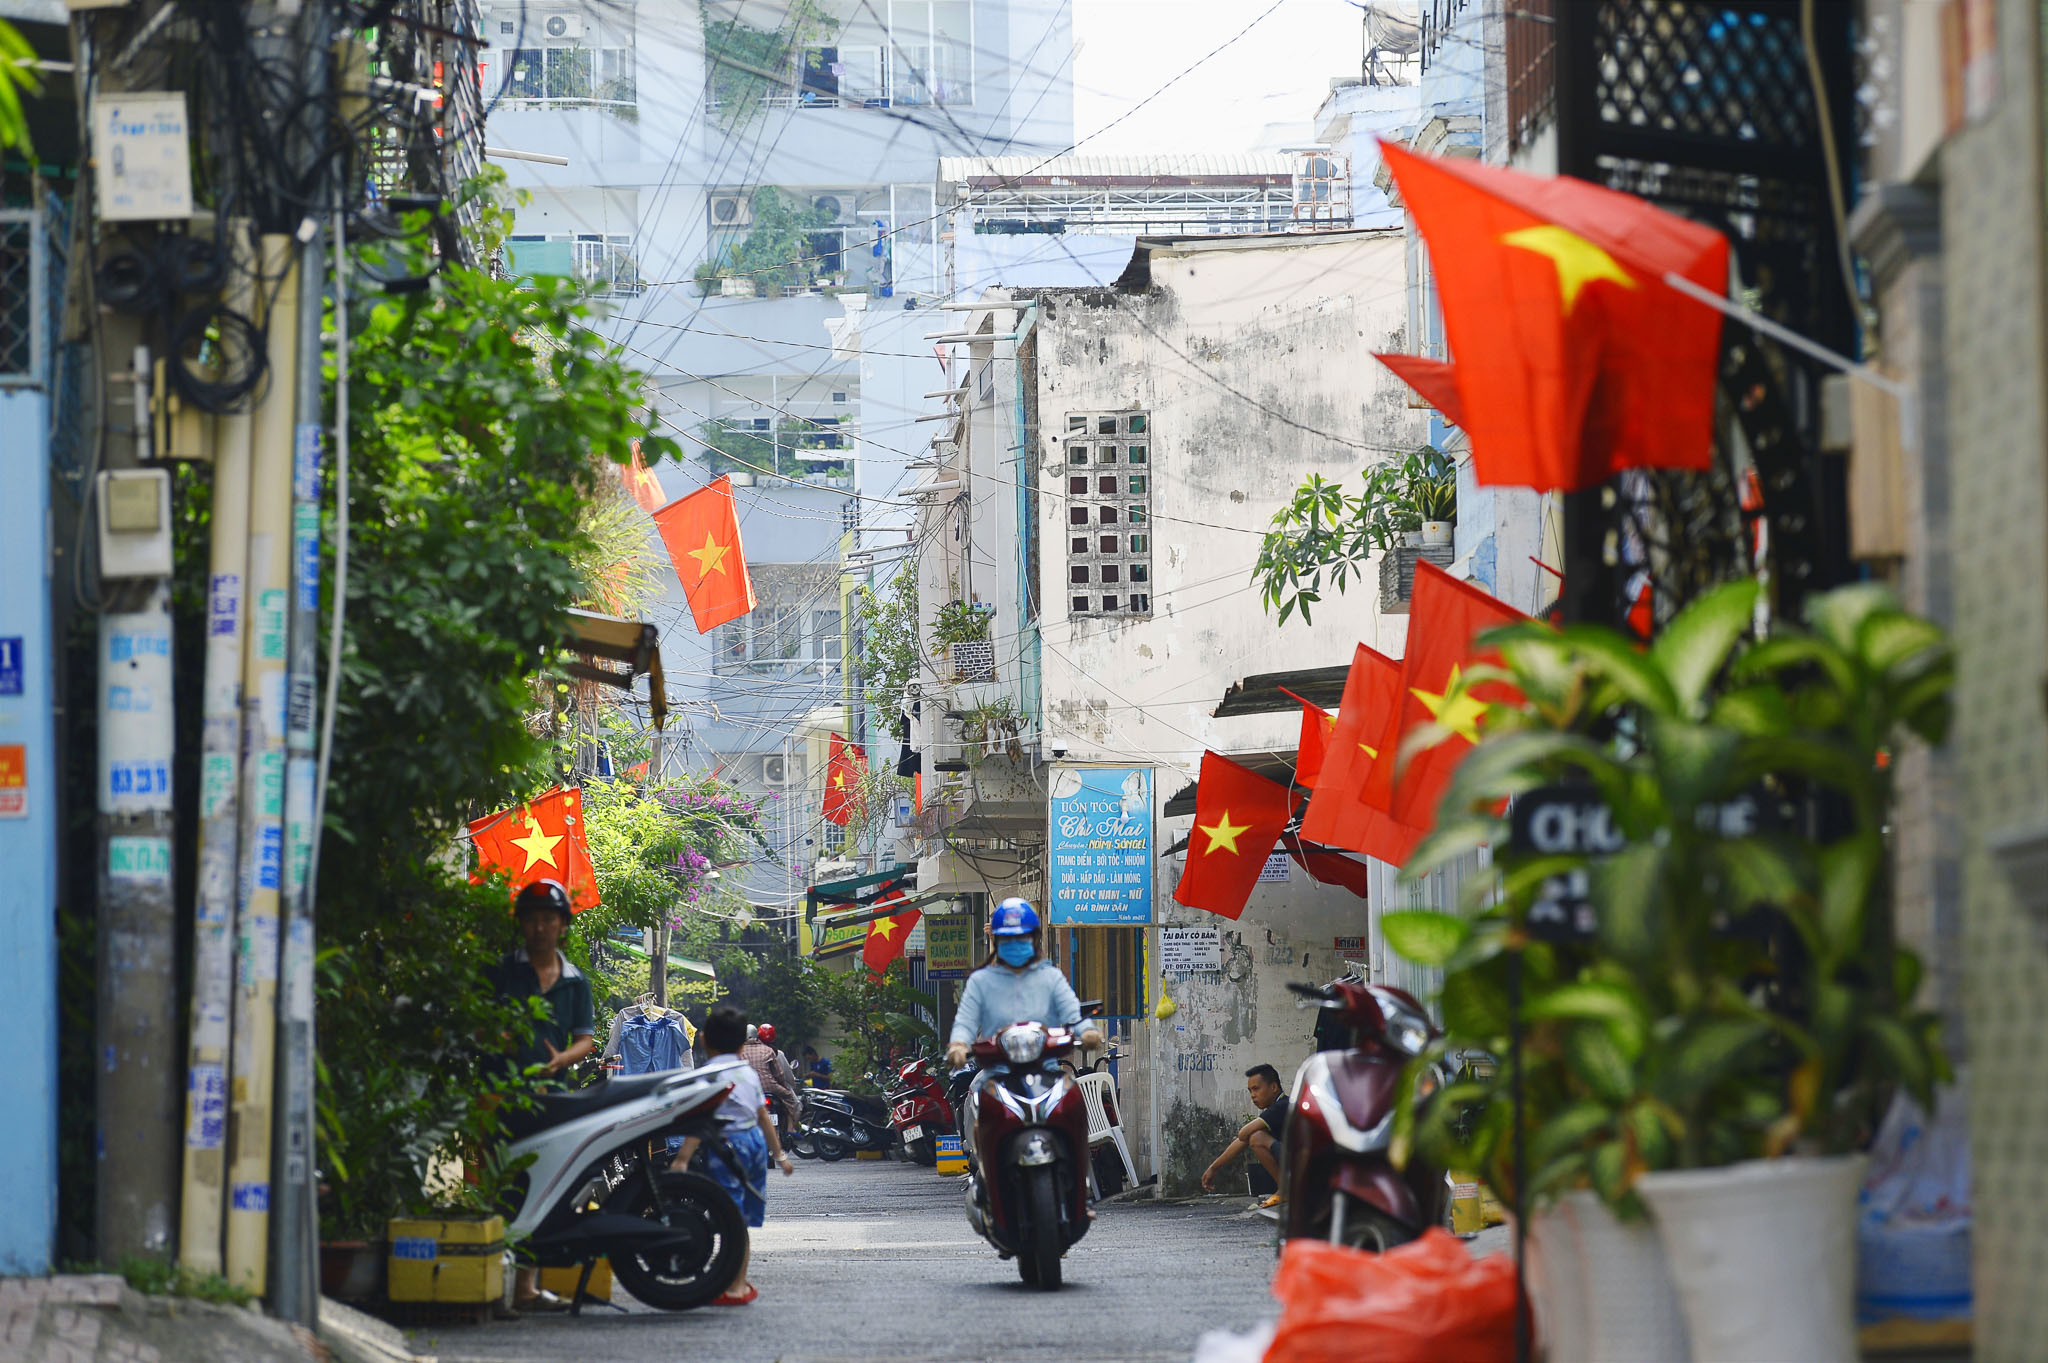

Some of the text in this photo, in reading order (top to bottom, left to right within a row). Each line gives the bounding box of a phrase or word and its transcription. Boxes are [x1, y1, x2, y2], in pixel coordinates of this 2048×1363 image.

[1090, 798, 1120, 813] TÓC
[1096, 816, 1145, 837] Mai
[1057, 855, 1075, 866] TRANG
[1108, 853, 1120, 866] TÓC
[1110, 870, 1123, 884] LÀM
[1124, 870, 1141, 884] MÓNG
[1078, 888, 1096, 900] TÓC
[1098, 889, 1120, 900] NAM
[1129, 887, 1144, 900] NỮ
[1075, 902, 1088, 912] GIÁ
[1091, 902, 1110, 912] BÌNH
[1190, 930, 1199, 939] CÓ
